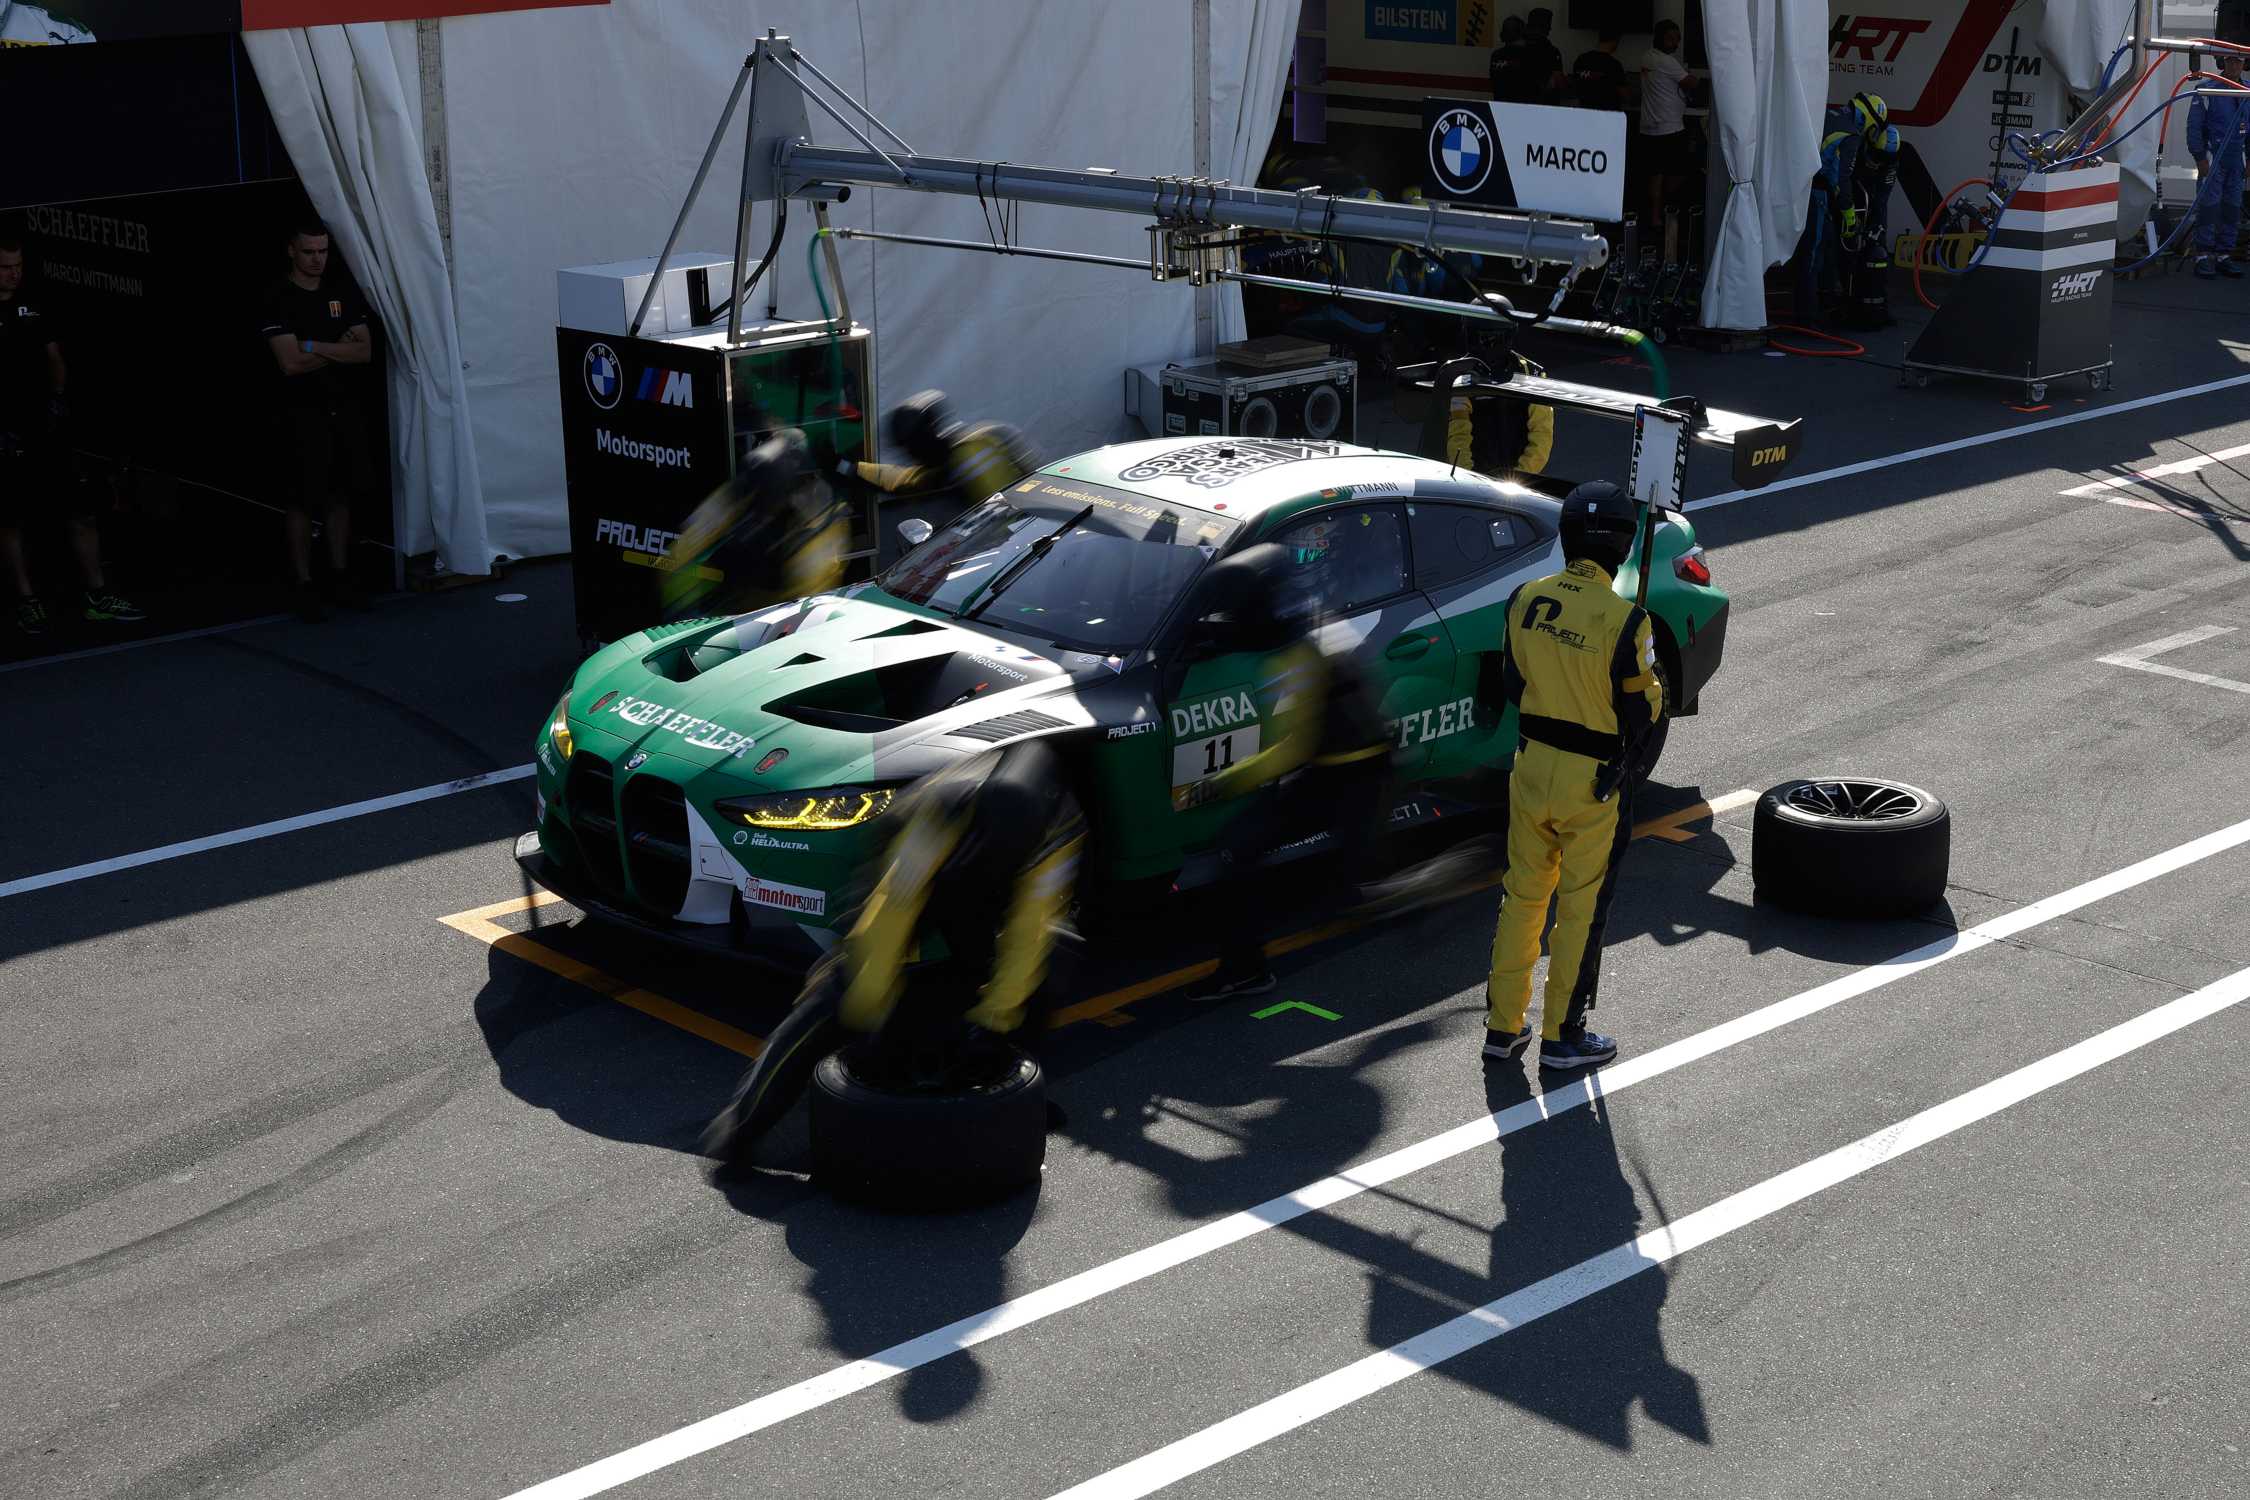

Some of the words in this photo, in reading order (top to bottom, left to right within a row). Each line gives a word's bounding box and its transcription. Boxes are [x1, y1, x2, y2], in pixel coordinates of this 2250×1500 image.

[1374, 6, 1447, 31] BILSTEIN
[1829, 15, 1932, 62] HRT
[1859, 64, 1894, 76] TEAM
[1983, 54, 2041, 75] DTM
[1525, 143, 1608, 174] MARCO
[26, 206, 150, 254] SCHAEFFLER
[42, 258, 82, 285] MARCO
[82, 269, 144, 297] WITTMANN
[596, 428, 691, 469] Motorsport
[1751, 445, 1786, 467] DTM
[1041, 485, 1065, 497] Less
[1118, 502, 1146, 516] Full
[1334, 481, 1400, 496] WITTMANN
[1536, 622, 1580, 641] PROJECT
[1579, 634, 1587, 644] 1
[967, 653, 1029, 683] Motorsport
[608, 696, 756, 759] SCHAEFFLER
[1171, 690, 1259, 738] DEKRA
[1107, 721, 1151, 740] PROJECT
[1151, 721, 1157, 732] 1
[1204, 734, 1235, 775] 11
[779, 841, 810, 851] ULTRA
